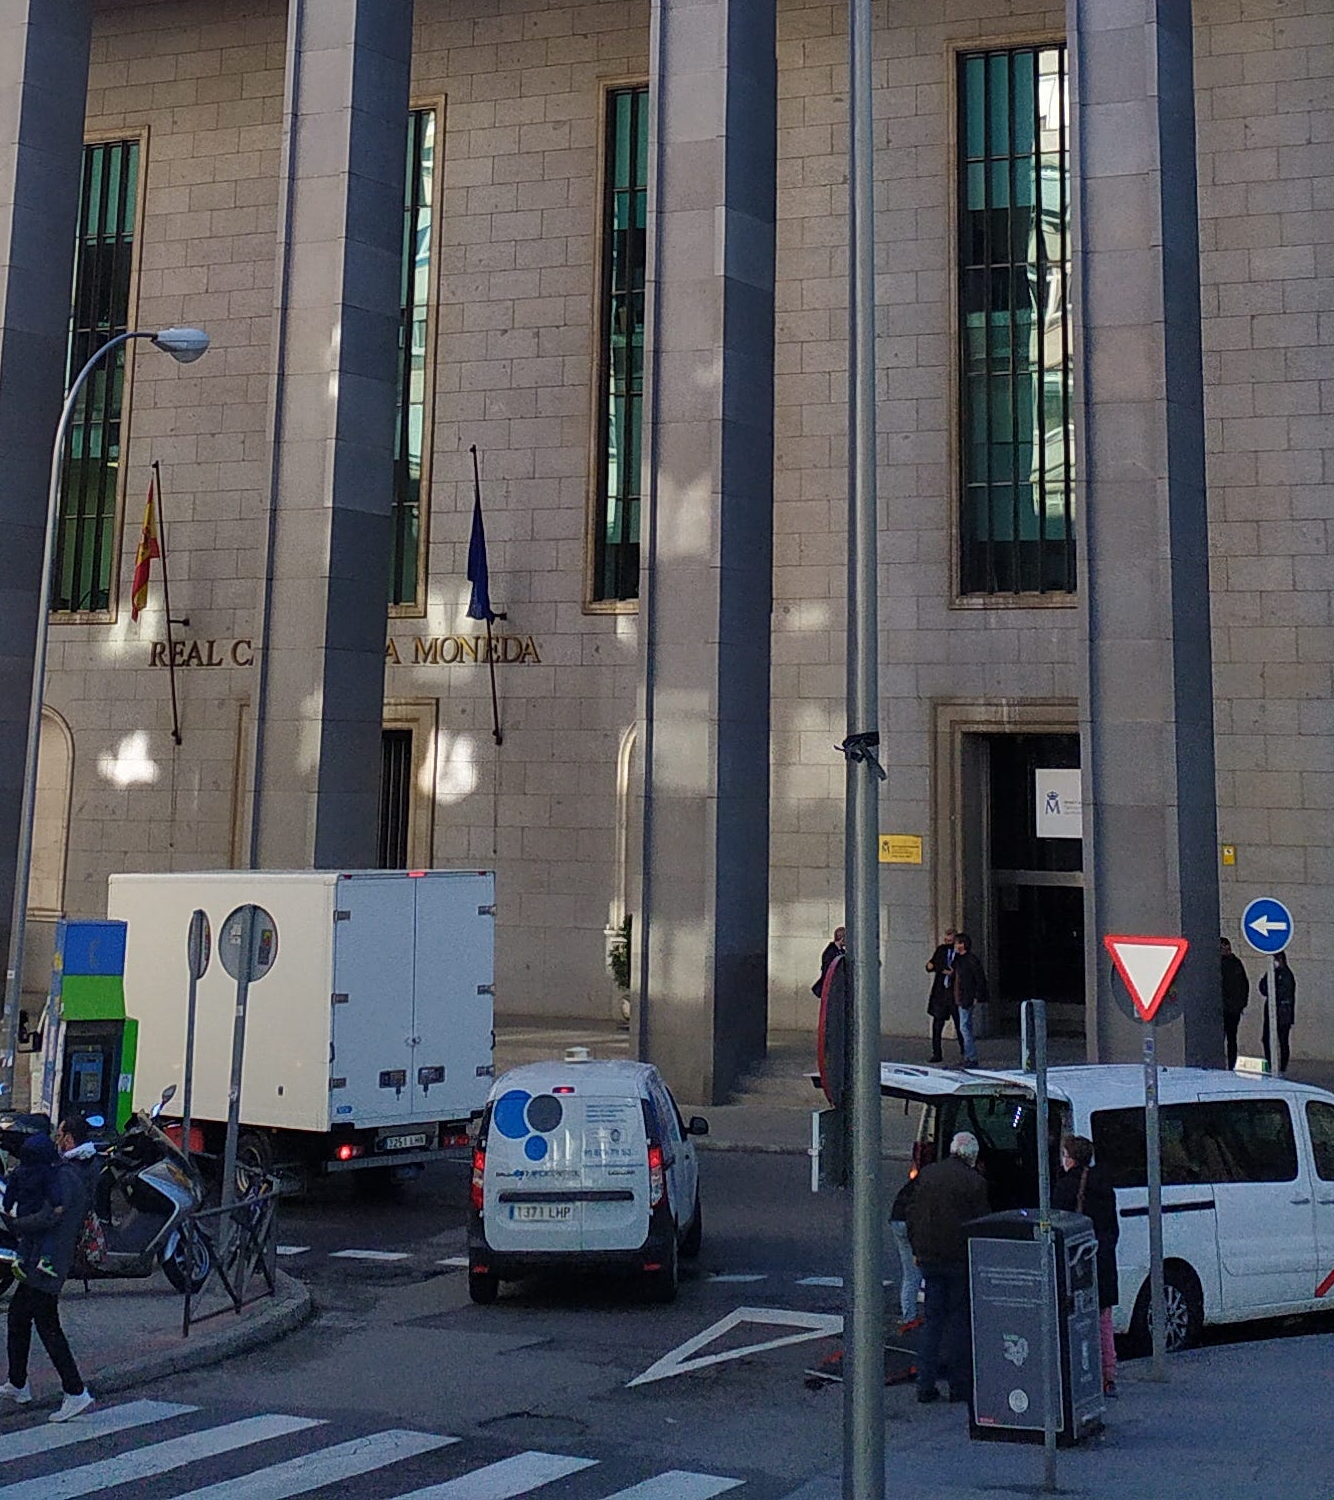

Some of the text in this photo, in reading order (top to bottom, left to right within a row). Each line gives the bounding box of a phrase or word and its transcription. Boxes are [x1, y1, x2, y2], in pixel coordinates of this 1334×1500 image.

[148, 639, 224, 668] REAL
[411, 635, 543, 665] MONEDA
[517, 1205, 571, 1219] 1371 LHP
